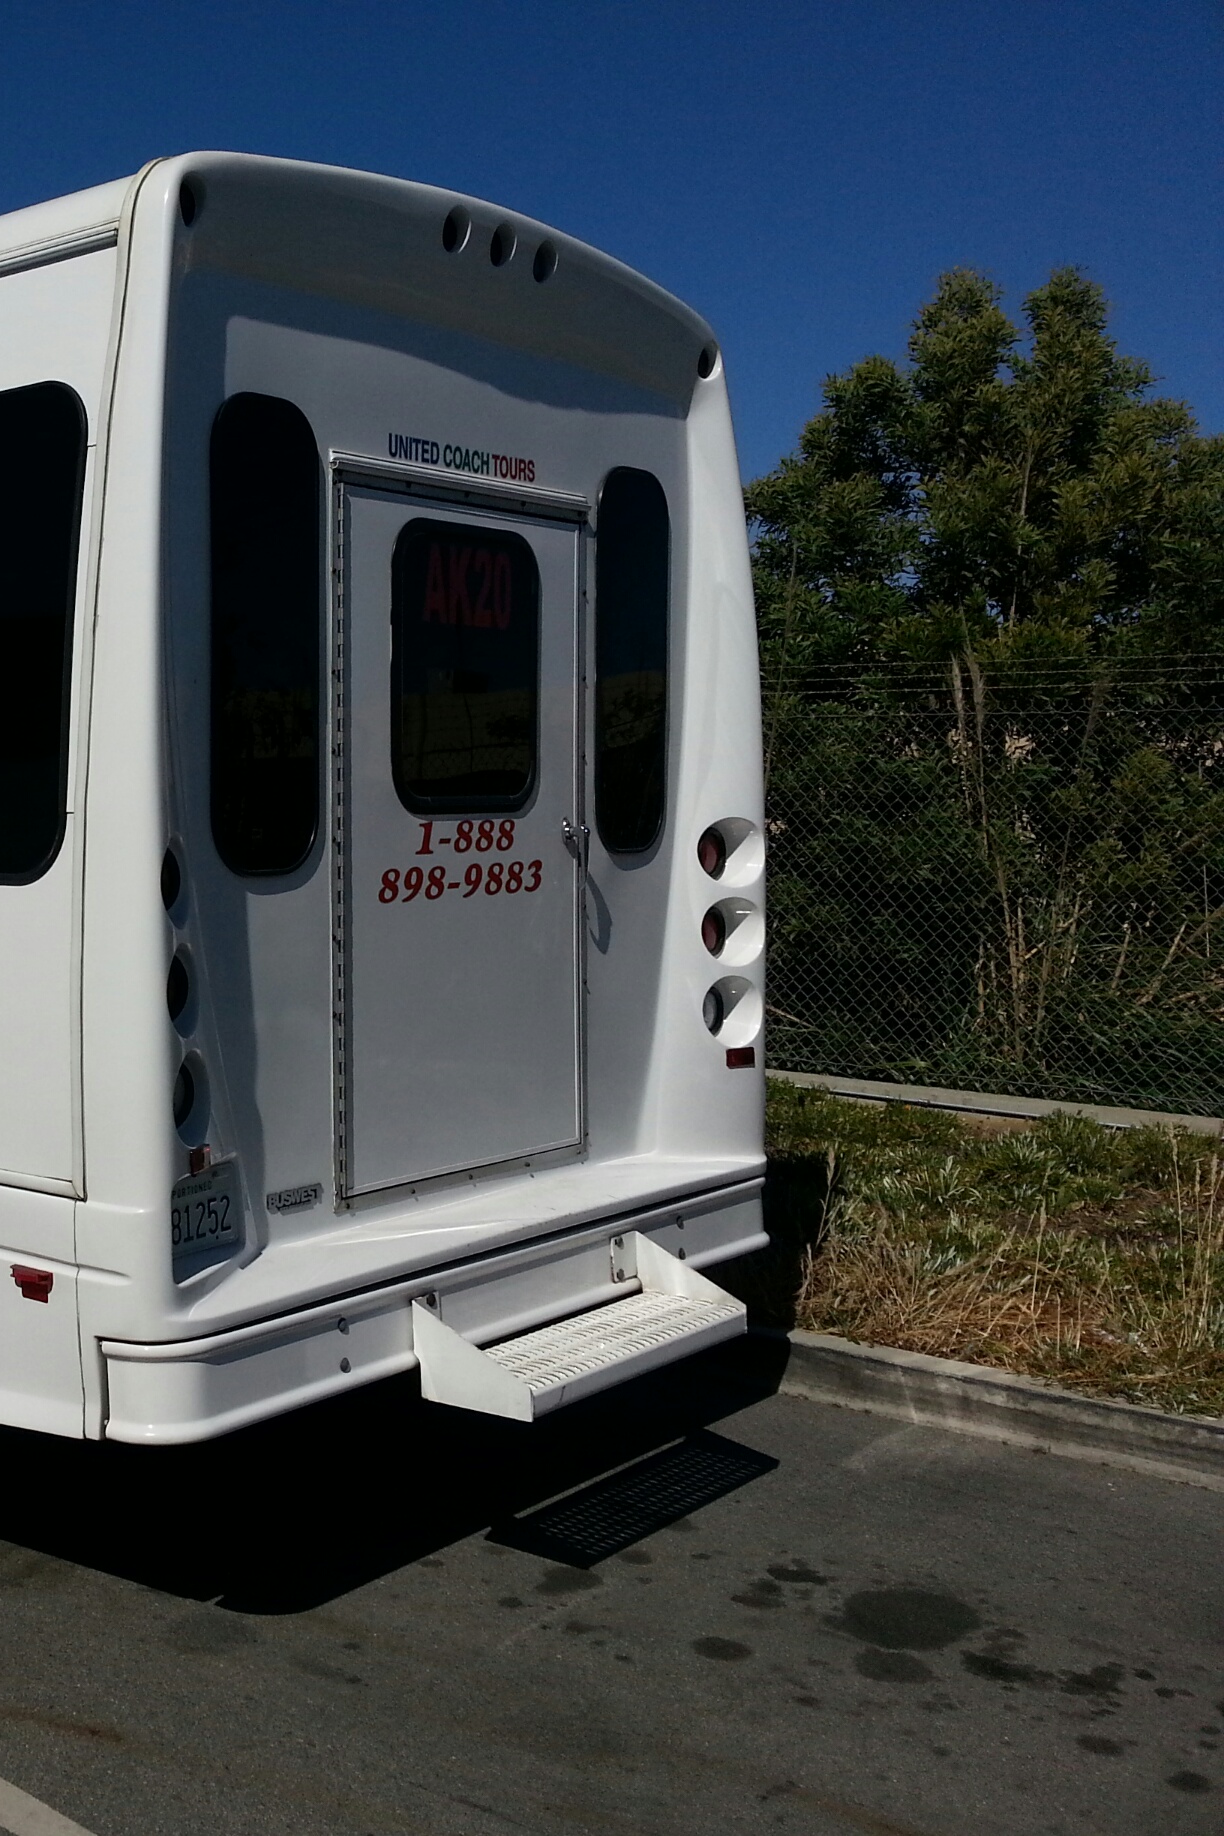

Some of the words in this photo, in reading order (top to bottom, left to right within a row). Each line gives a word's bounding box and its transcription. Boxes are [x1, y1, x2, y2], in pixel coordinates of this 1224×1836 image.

[388, 433, 440, 465] UNITED
[443, 444, 490, 475] COACH
[492, 454, 536, 482] TOURS
[421, 542, 512, 631] AK20
[415, 819, 516, 856] 1-888
[378, 860, 543, 903] 898-9883
[171, 1195, 232, 1246] 81252
[267, 1185, 321, 1211] BUSWEST
